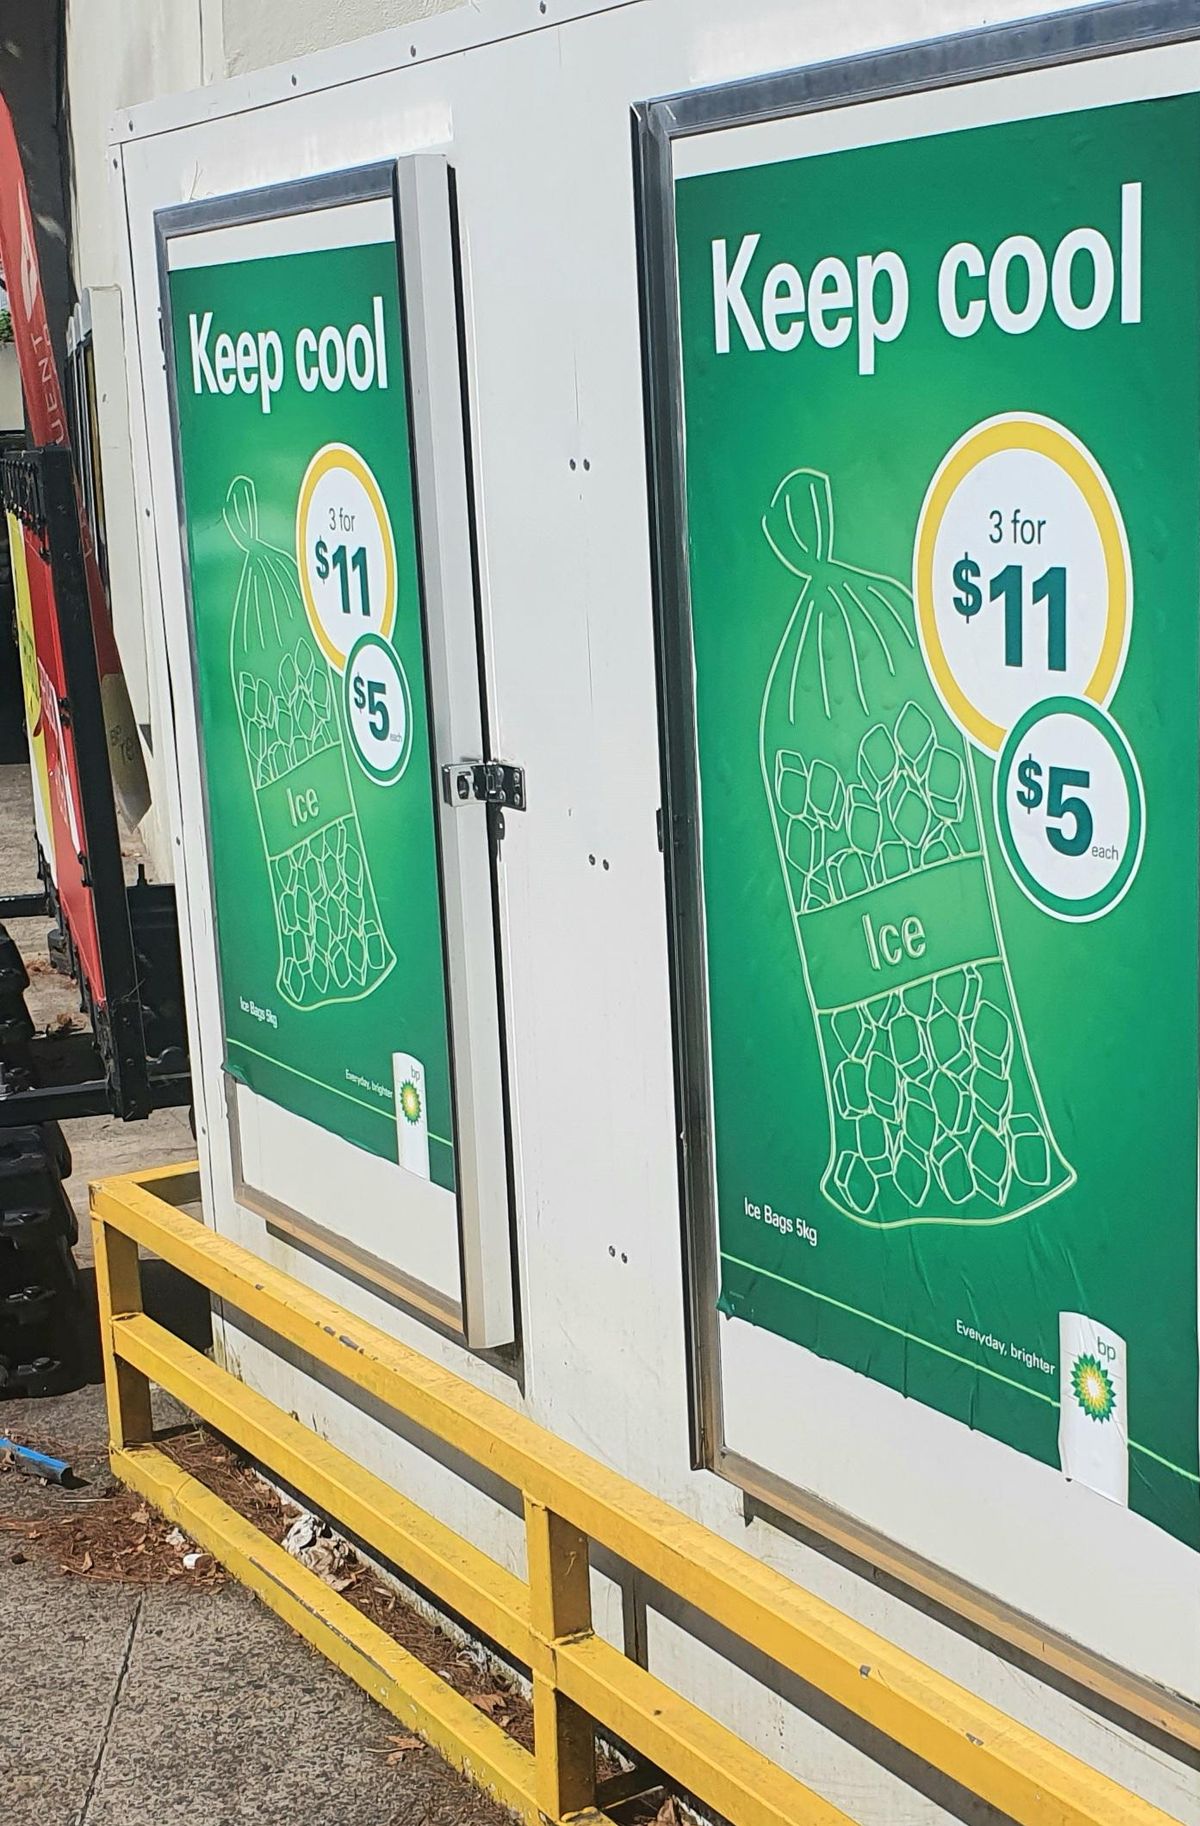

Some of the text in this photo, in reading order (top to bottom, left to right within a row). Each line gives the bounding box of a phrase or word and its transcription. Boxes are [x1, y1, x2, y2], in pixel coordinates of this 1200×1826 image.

[711, 181, 1142, 376] Keep cool
[188, 296, 388, 413] Keep cool
[328, 507, 356, 532] 3 for
[988, 509, 1047, 545] 3 for
[315, 535, 371, 617] $11
[952, 551, 1067, 672] $11
[353, 671, 390, 742] $5
[286, 787, 320, 827] Ice
[1016, 753, 1094, 857] $5
[1091, 844, 1120, 862] each
[862, 913, 927, 971] Ice
[240, 996, 250, 1013] Ice
[250, 1000, 266, 1022] Bags
[410, 1065, 421, 1082] bp
[744, 1197, 818, 1246] Ice Bags 5kg
[956, 1319, 1056, 1376] Everyday, brighter
[1096, 1336, 1116, 1363] bp
